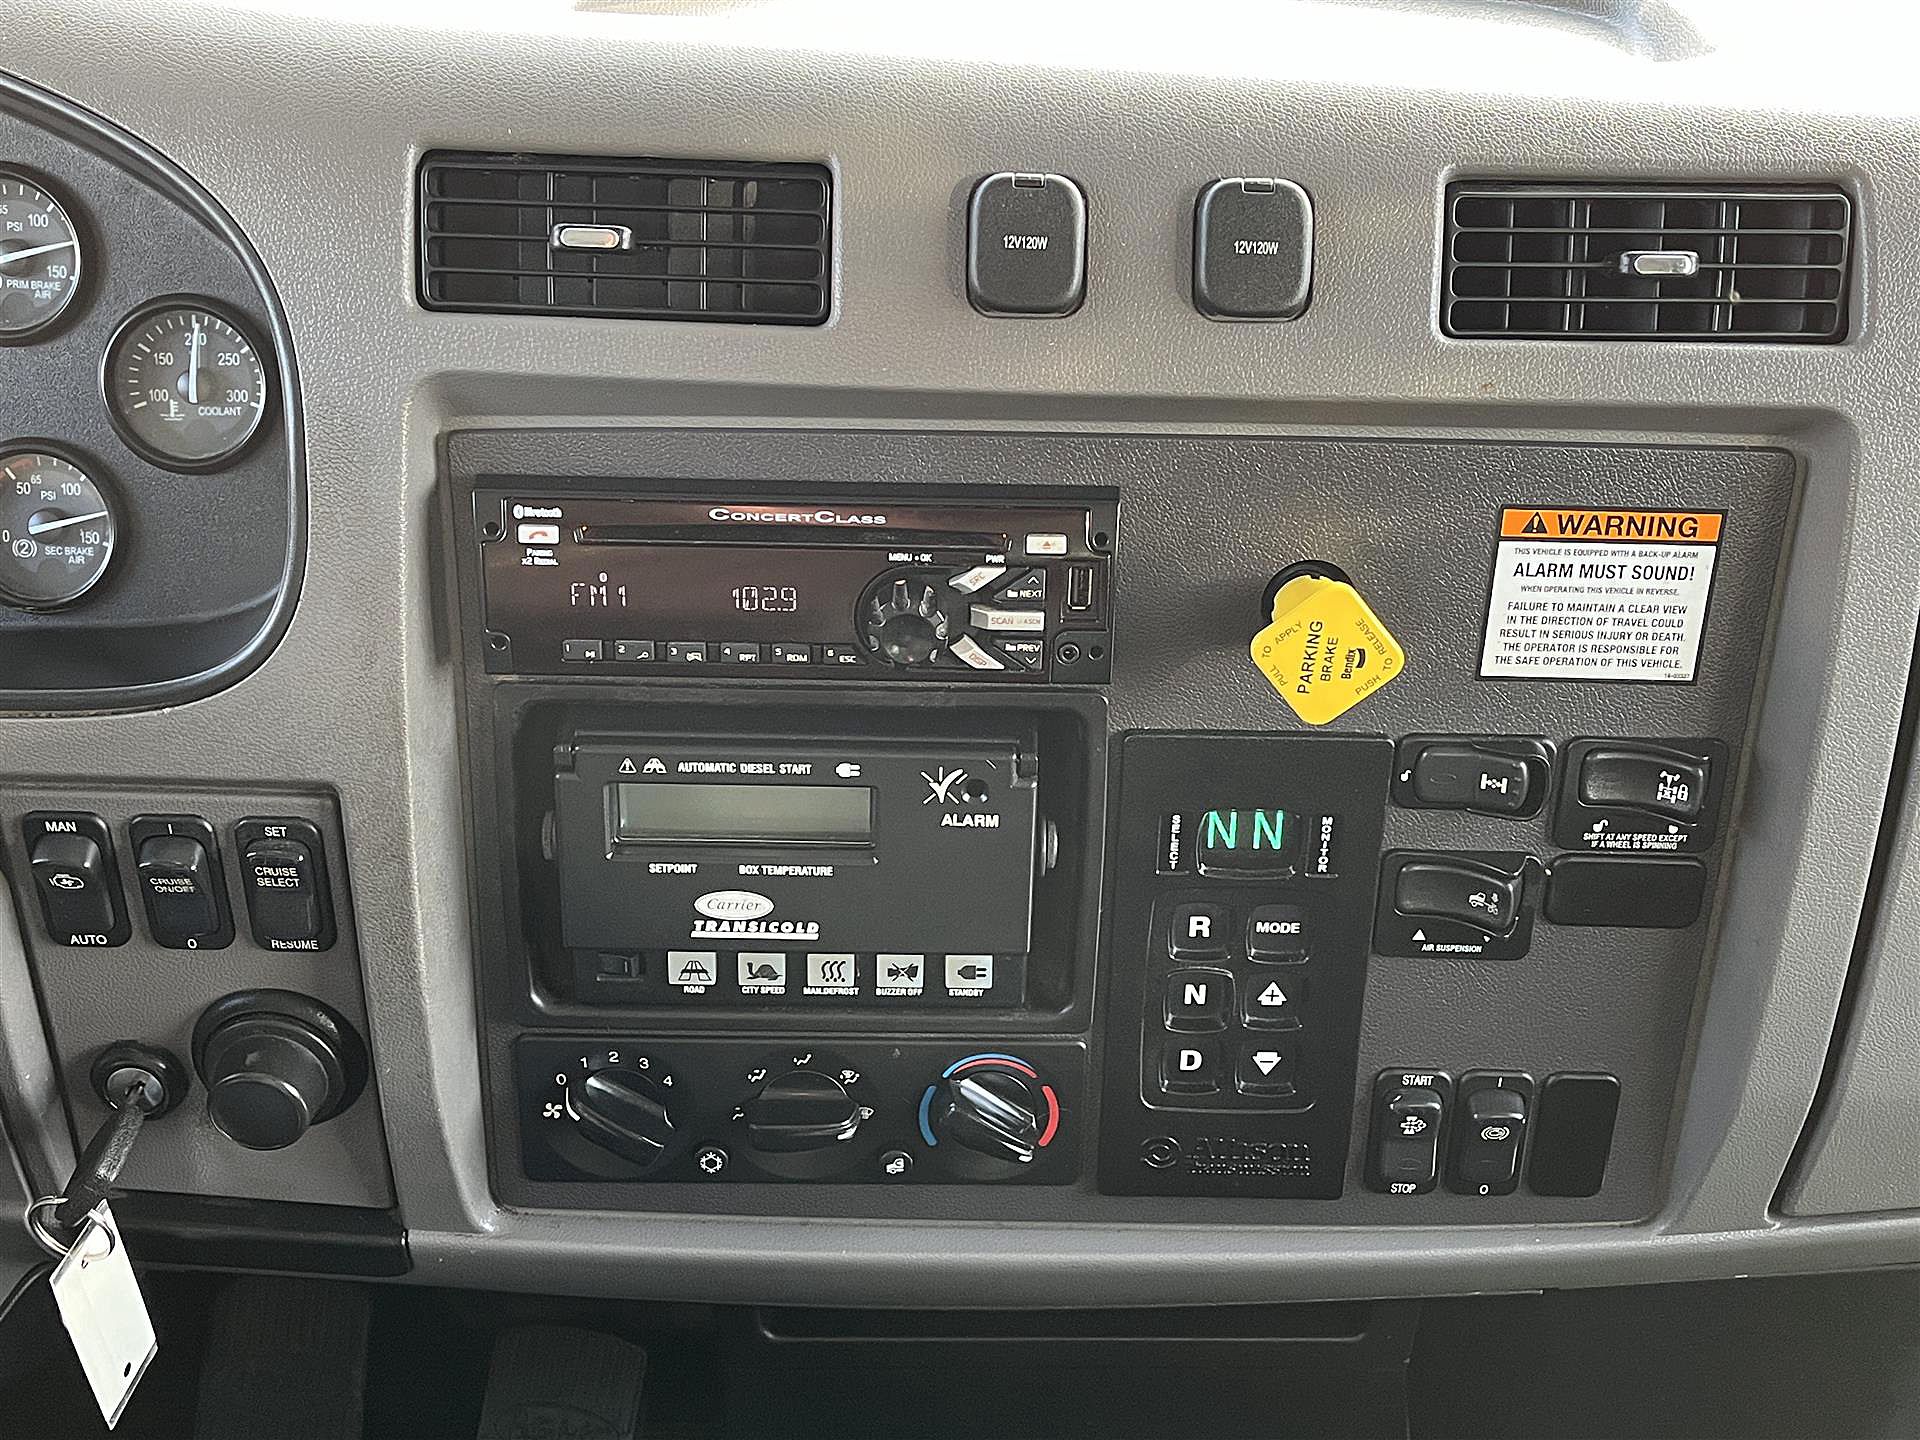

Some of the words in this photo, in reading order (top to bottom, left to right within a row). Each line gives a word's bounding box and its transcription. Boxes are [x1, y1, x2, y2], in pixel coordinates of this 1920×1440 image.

[6, 221, 23, 231] PSI
[27, 214, 49, 227] 100
[1002, 235, 1048, 249] 12V120W
[1234, 240, 1279, 255] 12V120W
[46, 265, 67, 279] 150
[6, 279, 29, 289] PRIM
[31, 281, 61, 291] BRAKE
[34, 290, 52, 299] AIR
[184, 333, 207, 346] 20
[153, 353, 174, 366] 150
[217, 353, 240, 366] 250
[149, 390, 169, 402] 100
[226, 390, 249, 403] 300
[198, 406, 242, 416] COOLANT
[31, 475, 42, 485] 65
[16, 482, 31, 495] 50
[61, 483, 81, 496] 100
[40, 491, 57, 501] PSI
[1557, 513, 1699, 538] WARNING
[2, 530, 10, 543] 0
[80, 532, 100, 545] 150
[44, 546, 63, 556] SEC
[64, 547, 95, 556] BRAKE
[888, 553, 913, 562] MENU
[1514, 547, 1530, 555] THIS
[1532, 548, 1562, 556] VEHICLE
[1564, 548, 1571, 556] IS
[1573, 549, 1609, 557] EQUIPPED
[1611, 549, 1629, 558] WITH
[1638, 550, 1672, 558] BACK-UP
[1672, 551, 1699, 559] ALARM
[68, 555, 85, 565] AIR
[986, 554, 1005, 563] PWR
[1512, 562, 1574, 579] ALARM
[1578, 563, 1628, 580] MUST
[1631, 564, 1695, 581] SOUND!
[1020, 590, 1042, 598] NEXT
[1520, 585, 1542, 593] WHEN
[1543, 585, 1585, 594] OPERATING
[1587, 586, 1603, 594] THIS
[1605, 587, 1634, 595] VEHICLE
[1507, 601, 1548, 611] FAILURE
[1551, 602, 1564, 612] TO
[1566, 603, 1616, 613] MAINTAIN
[1618, 603, 1625, 613] A
[1628, 604, 1660, 614] CLEAR
[1663, 605, 1688, 615] VIEW
[991, 616, 1014, 625] SCAN
[1506, 615, 1517, 625] IN
[1520, 615, 1539, 625] THE
[1541, 616, 1594, 626] DIRECTION
[1596, 617, 1609, 627] OF
[1612, 617, 1649, 628] TRAVEL
[1651, 618, 1684, 629] COULD
[1274, 621, 1303, 644] APPLY
[1355, 618, 1388, 655] RELEASE
[1499, 628, 1537, 638] RESULT
[1539, 629, 1550, 638] IN
[1552, 629, 1594, 640] SERIOUS
[1597, 631, 1633, 641] INJURY
[1635, 631, 1649, 641] OR
[618, 644, 626, 653] 2
[670, 647, 678, 656] 3
[723, 647, 731, 656] 4
[1017, 644, 1040, 652] PREV
[1262, 645, 1273, 659] TO
[1503, 642, 1521, 652] THE
[1523, 643, 1576, 653] OPERATOR
[1578, 644, 1588, 654] IS
[1590, 644, 1658, 655] RESPONSIBLE
[1660, 645, 1679, 655] FOR
[1297, 620, 1323, 694] PARKING
[1320, 637, 1339, 682] BRAKE
[1495, 655, 1513, 665] THE
[1515, 656, 1540, 666] SAFE
[1542, 656, 1598, 667] OPERATION
[1600, 658, 1615, 667] OF
[1617, 658, 1638, 668] THIS
[1341, 649, 1358, 680] Bendix
[1382, 657, 1393, 671] TO
[1270, 664, 1289, 687] PULL
[1355, 674, 1381, 695] PUSH
[677, 761, 737, 774] AUTOMATIC
[740, 763, 776, 775] DIESEL
[779, 763, 812, 775] START
[45, 821, 77, 832] MAN
[940, 813, 1000, 828] ALARM
[264, 826, 287, 838] SET
[1583, 832, 1605, 840] SHIFT
[1616, 833, 1632, 841] ANY
[1632, 834, 1657, 842] SPEED
[1169, 814, 1182, 870] SELECT
[1317, 816, 1334, 873] MONITOR
[1606, 841, 1632, 849] WHEEL
[1642, 842, 1677, 850] SPINNING
[254, 866, 299, 877] CRUISE
[648, 863, 698, 875] SETPOINT
[738, 865, 760, 876] BOX
[761, 865, 834, 877] TEMPERATURE
[150, 877, 193, 886] CRUISE
[256, 877, 301, 888] SELECT
[707, 898, 762, 911] Carrier
[693, 920, 820, 935] TRANSICOLD
[1188, 915, 1211, 938] R
[1255, 921, 1301, 934] MODE
[70, 934, 108, 945] AUTO
[271, 939, 319, 950] RESUME
[1421, 943, 1434, 952] AIR
[1436, 944, 1482, 953] SUSPENSION
[683, 986, 706, 994] ROAD
[741, 986, 760, 994] CITY
[760, 986, 786, 995] SPEED
[876, 988, 907, 996] BUZZER
[907, 988, 923, 996] OFF
[949, 989, 985, 997] STANDBY
[1183, 984, 1207, 1005] N
[580, 1056, 589, 1069] 1
[608, 1051, 619, 1063] 2
[638, 1057, 650, 1070] 3
[1179, 1050, 1203, 1071] D
[662, 1075, 673, 1087] 4
[1402, 1074, 1434, 1086] START
[1390, 1183, 1416, 1194] STOP
